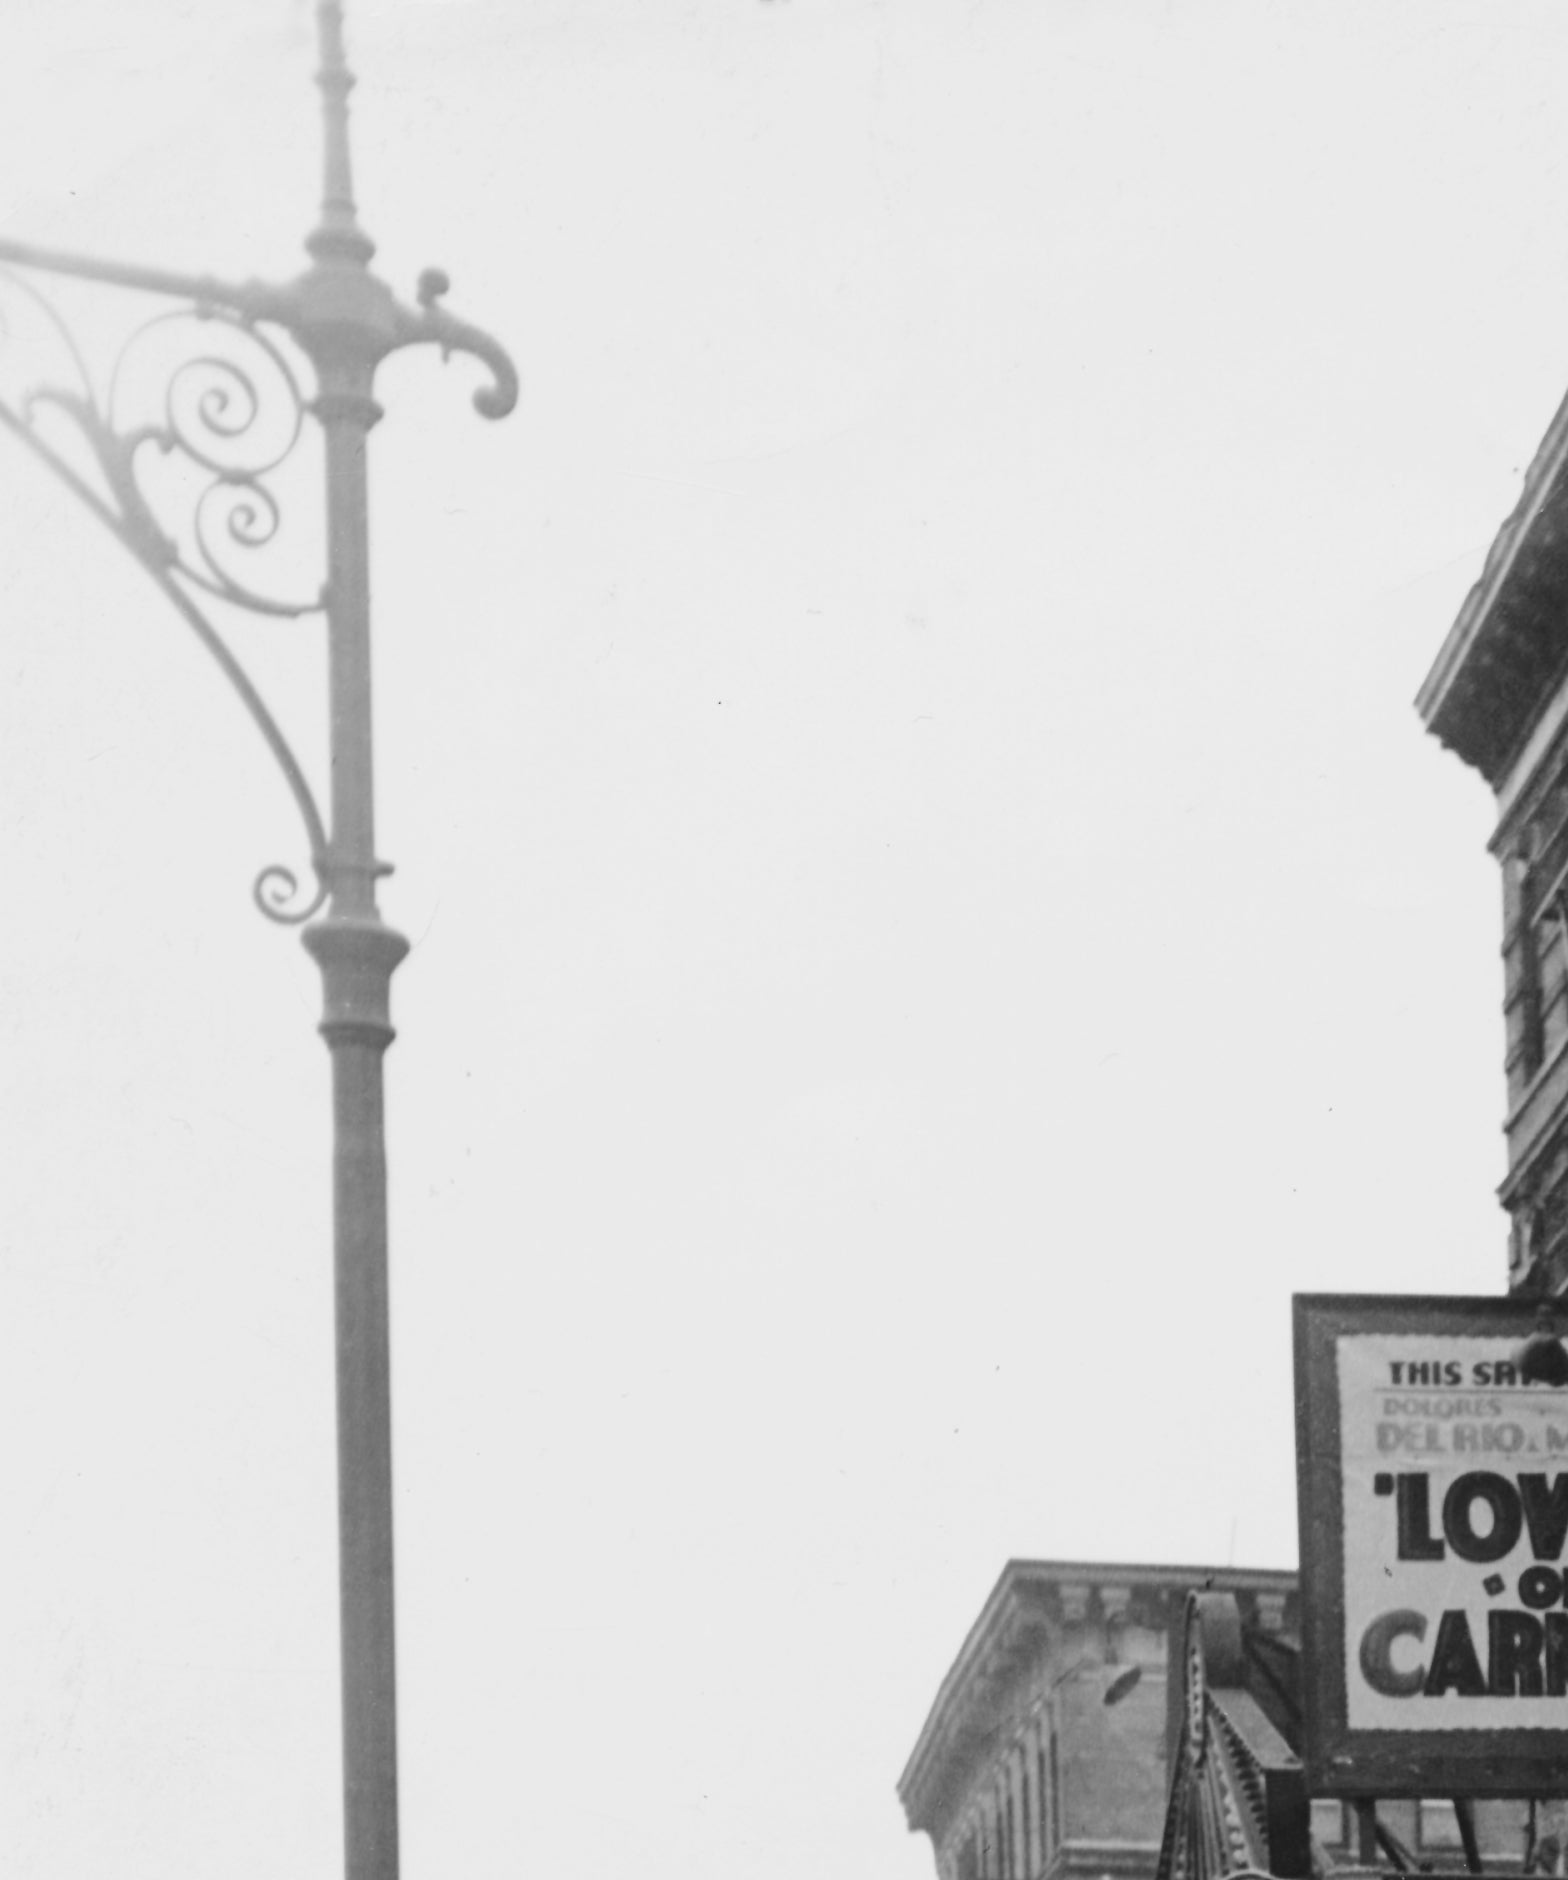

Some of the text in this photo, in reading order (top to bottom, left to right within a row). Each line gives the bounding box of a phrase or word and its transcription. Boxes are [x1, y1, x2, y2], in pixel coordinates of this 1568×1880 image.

[1389, 1360, 1463, 1387] THIS
[1375, 1422, 1447, 1454] DEL
[1452, 1422, 1525, 1454] RIO
